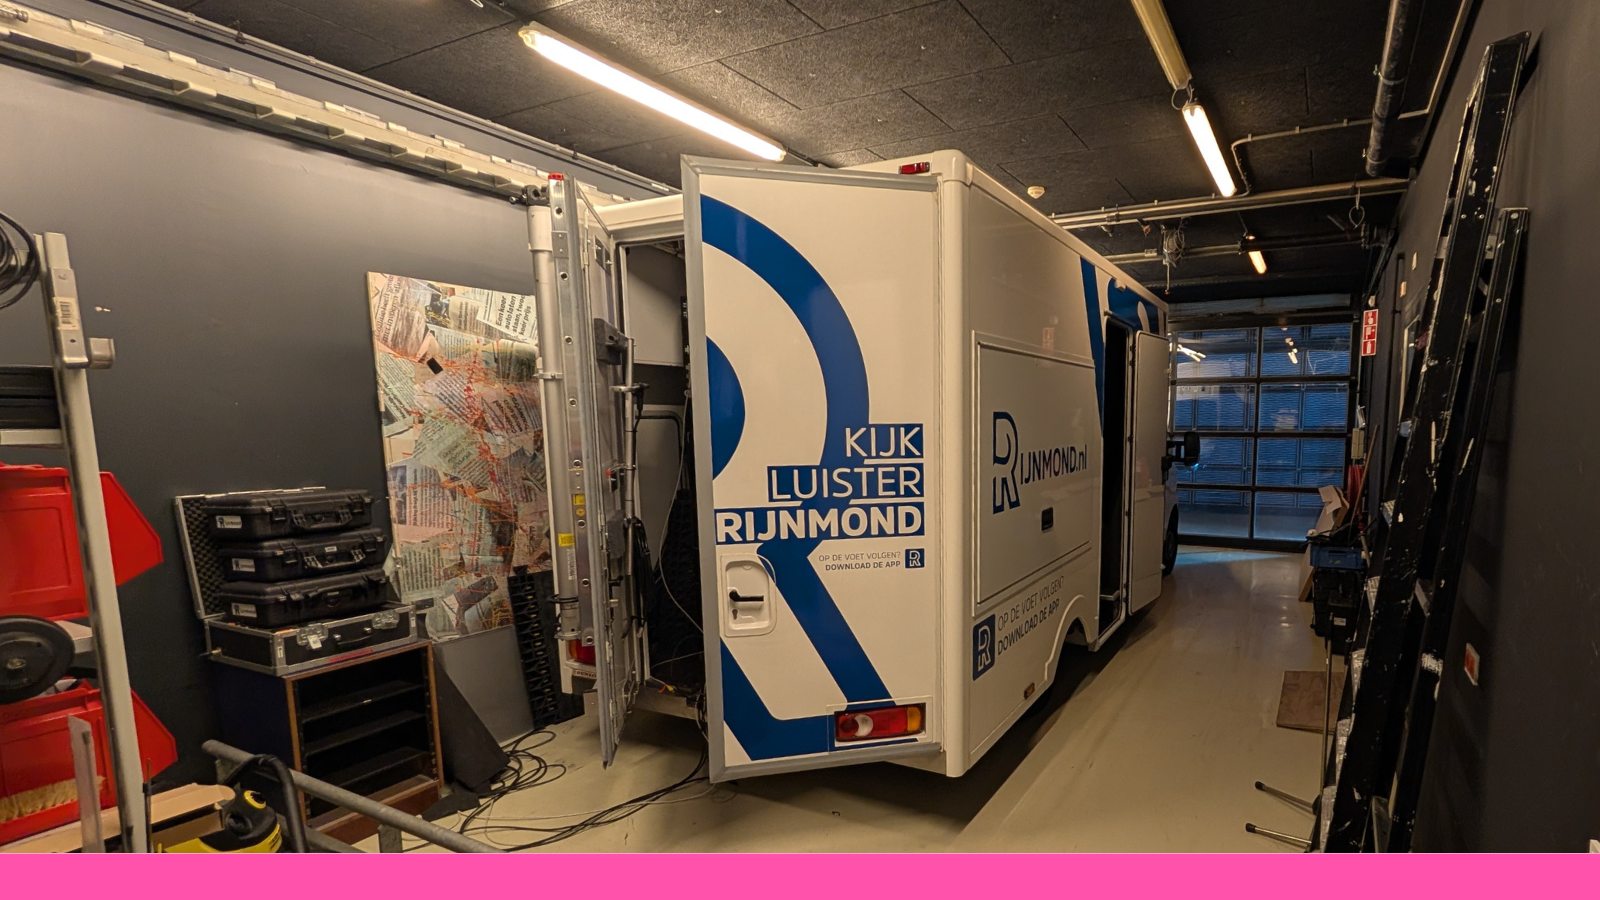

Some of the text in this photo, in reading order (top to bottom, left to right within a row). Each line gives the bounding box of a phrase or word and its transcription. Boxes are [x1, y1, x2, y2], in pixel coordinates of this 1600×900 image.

[496, 296, 507, 326] Een keer
[507, 296, 516, 314] laten
[518, 320, 527, 335] keer
[845, 427, 921, 457] KIJK
[772, 466, 921, 499] LUISTER
[716, 505, 922, 542] RIJNMOND
[825, 562, 871, 571] DOWNLOAD
[844, 553, 864, 561] VOET
[866, 551, 901, 560] VOLGEN?
[997, 575, 1064, 631] OP DE VOET VOLGEN?
[998, 598, 1060, 656] DOWNLOAD DE APP
